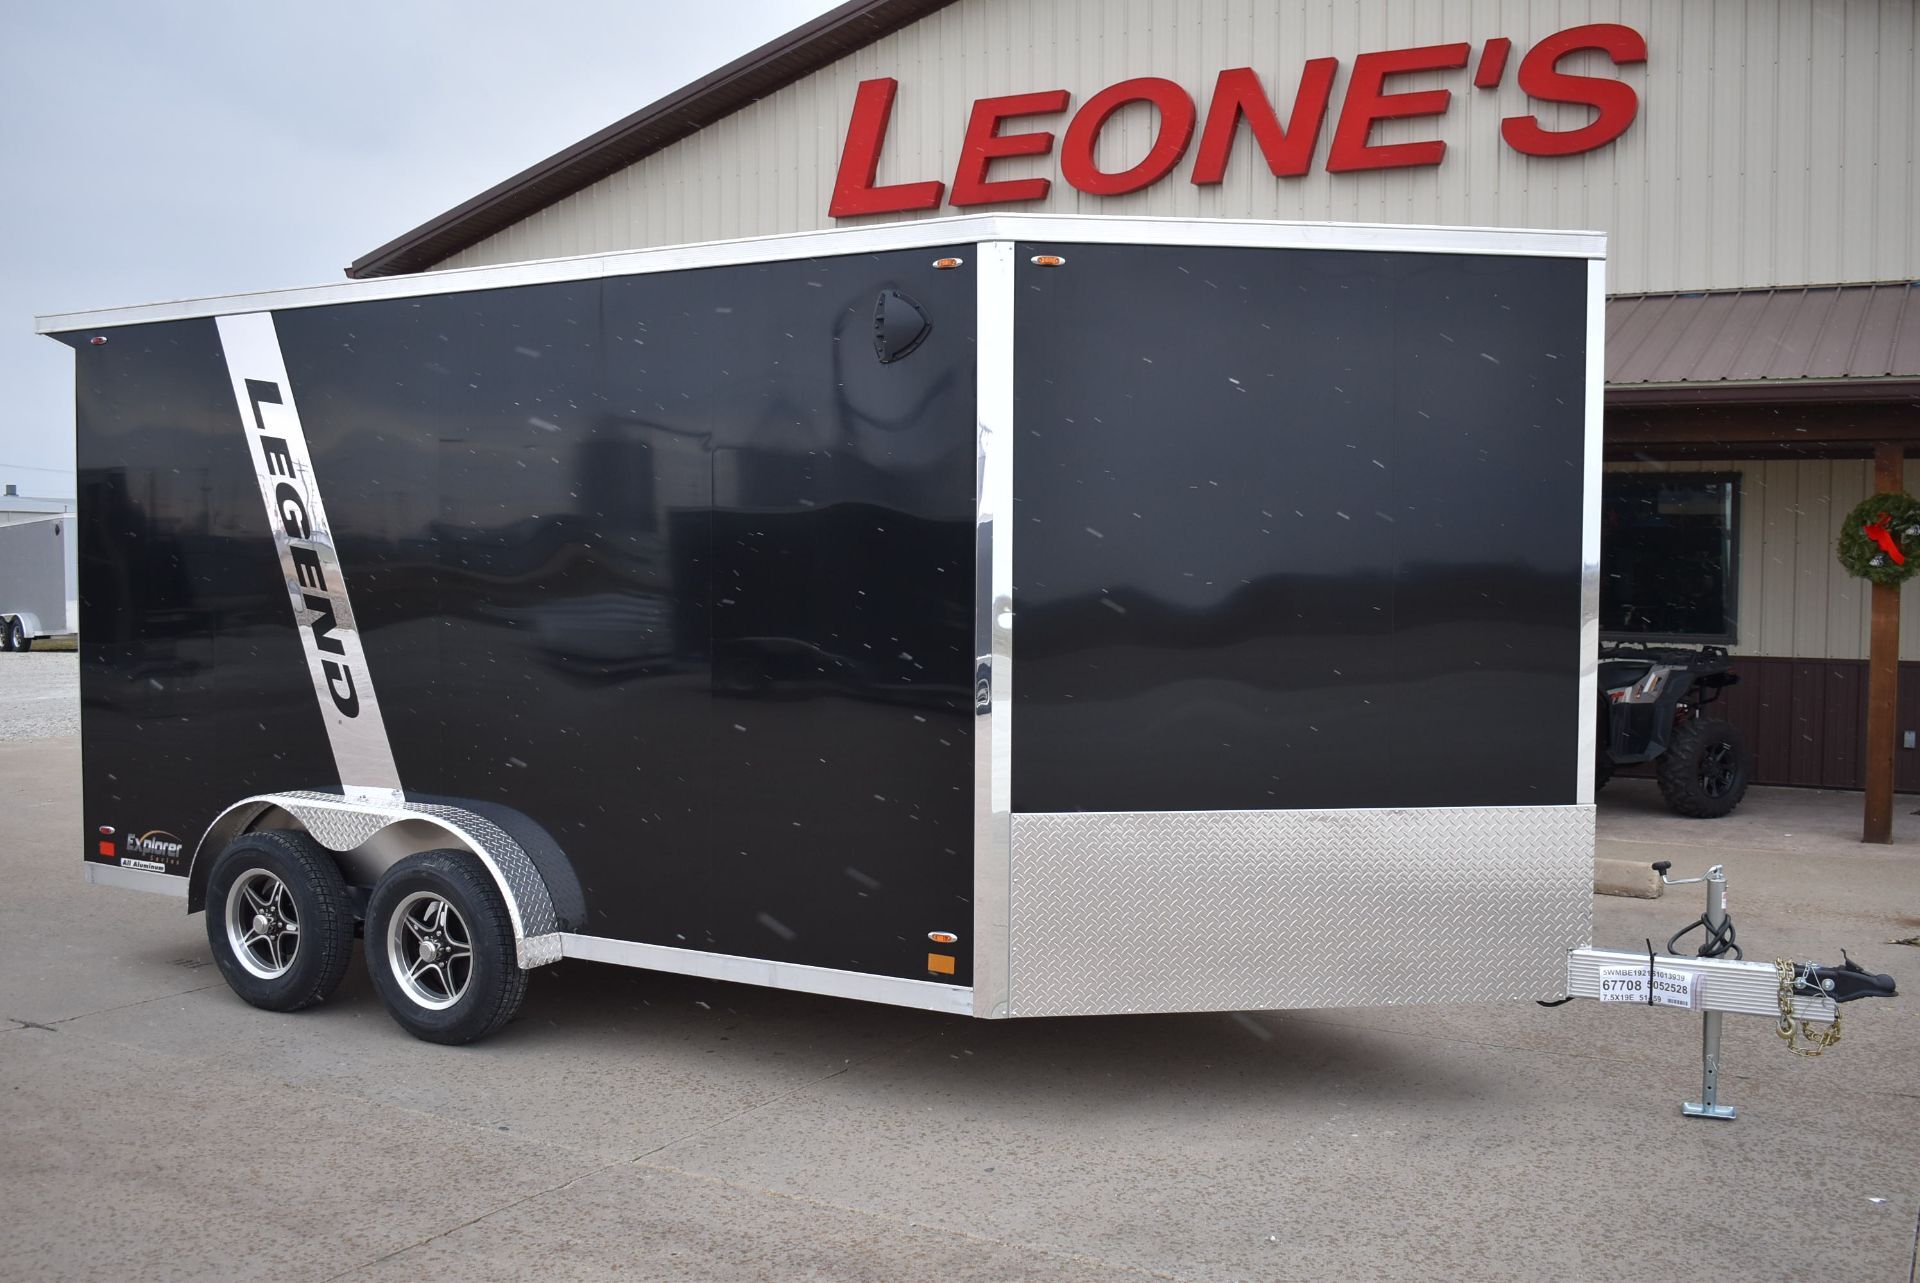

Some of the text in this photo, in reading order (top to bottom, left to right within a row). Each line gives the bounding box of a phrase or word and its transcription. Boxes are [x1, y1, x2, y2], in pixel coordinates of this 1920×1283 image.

[828, 23, 1648, 218] LEONE'S
[244, 378, 359, 719] LEGEND
[126, 833, 183, 857] Explorer
[122, 859, 164, 871] All Aluminum
[1602, 980, 1642, 991] 67708
[1639, 994, 1662, 1002] 5159
